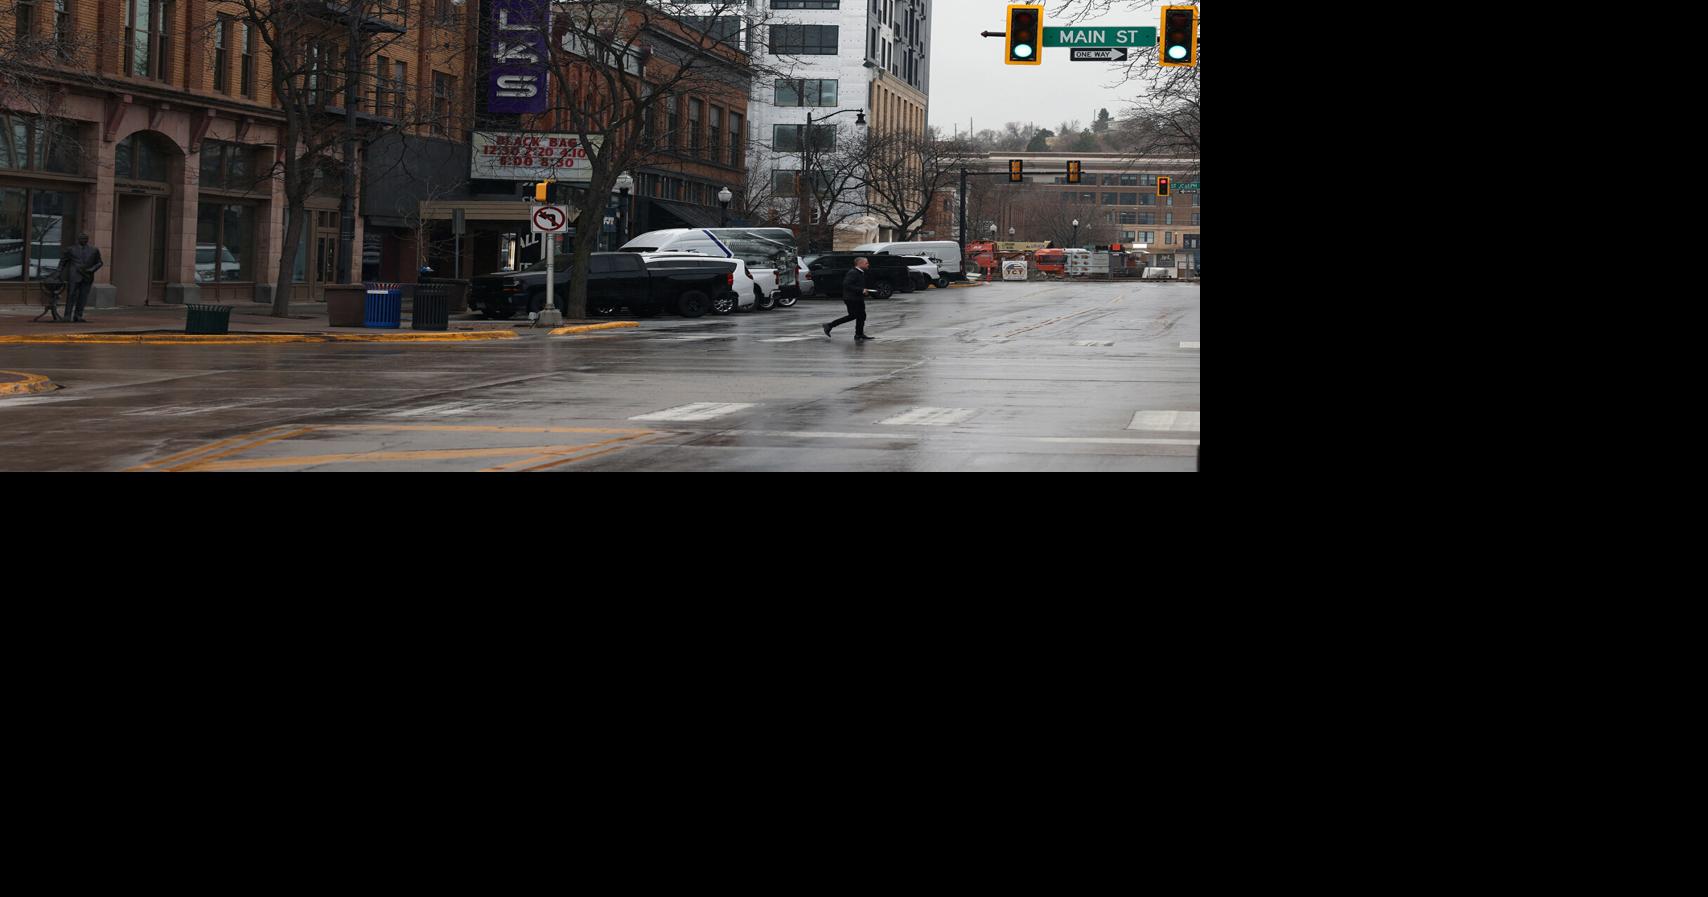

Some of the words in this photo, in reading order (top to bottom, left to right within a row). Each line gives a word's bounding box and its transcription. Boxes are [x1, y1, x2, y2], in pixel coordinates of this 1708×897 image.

[1060, 30, 1105, 43] MAIN
[1116, 30, 1138, 43] ST
[496, 136, 539, 146] BLACK
[549, 138, 577, 147] BAG
